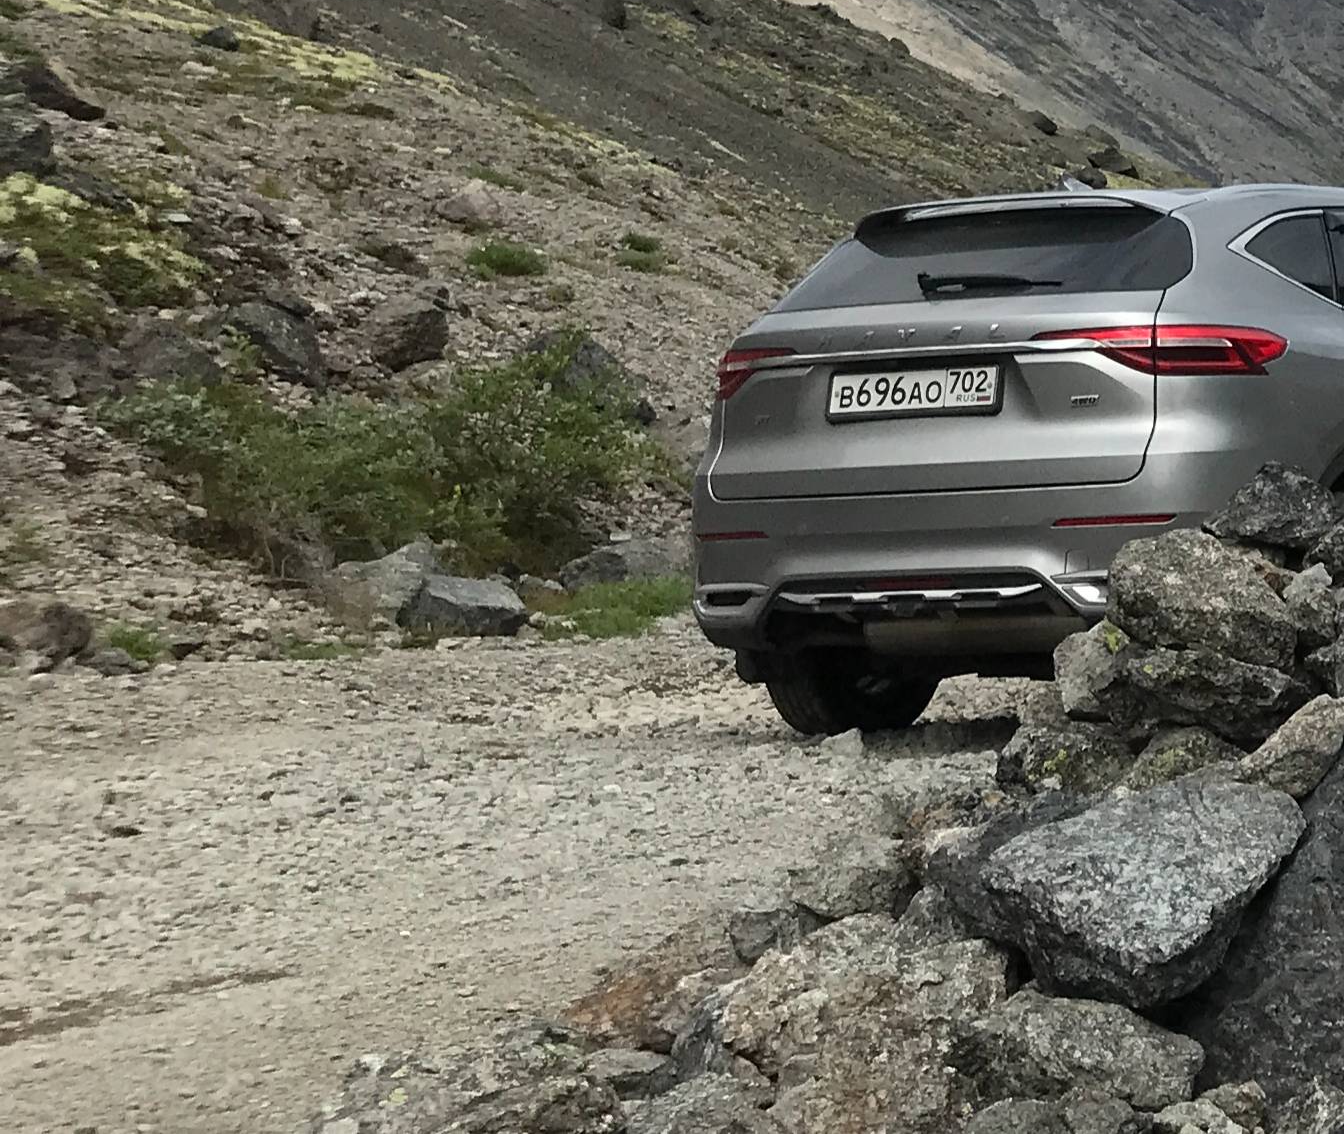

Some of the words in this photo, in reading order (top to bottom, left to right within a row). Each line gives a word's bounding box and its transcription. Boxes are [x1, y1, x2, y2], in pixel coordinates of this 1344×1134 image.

[839, 376, 943, 409] В696АО
[949, 370, 989, 394] 702
[956, 393, 976, 402] RUS
